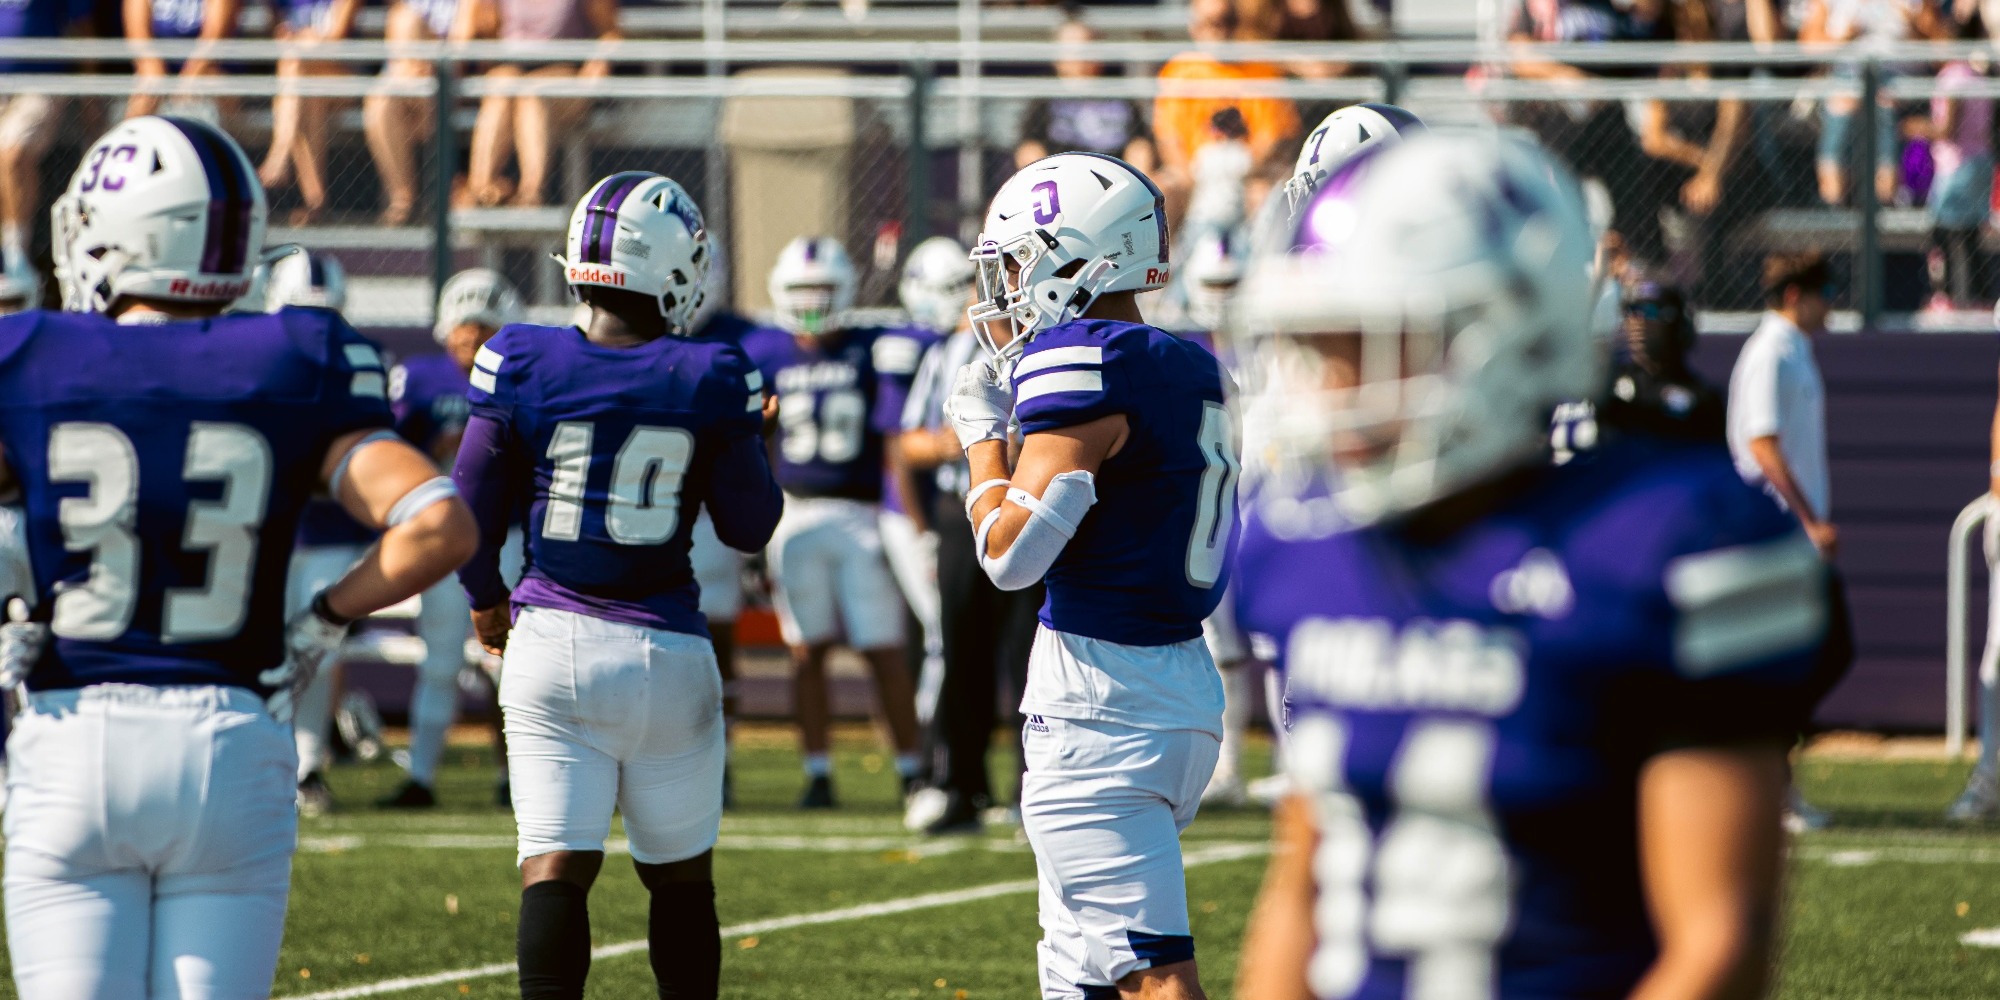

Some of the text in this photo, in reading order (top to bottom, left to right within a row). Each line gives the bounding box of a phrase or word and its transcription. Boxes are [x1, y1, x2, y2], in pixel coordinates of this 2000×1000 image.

[1310, 126, 1330, 166] 7
[570, 268, 625, 286] Riddell
[47, 420, 274, 645] 33
[541, 420, 695, 546] 10
[1184, 399, 1242, 589] 0
